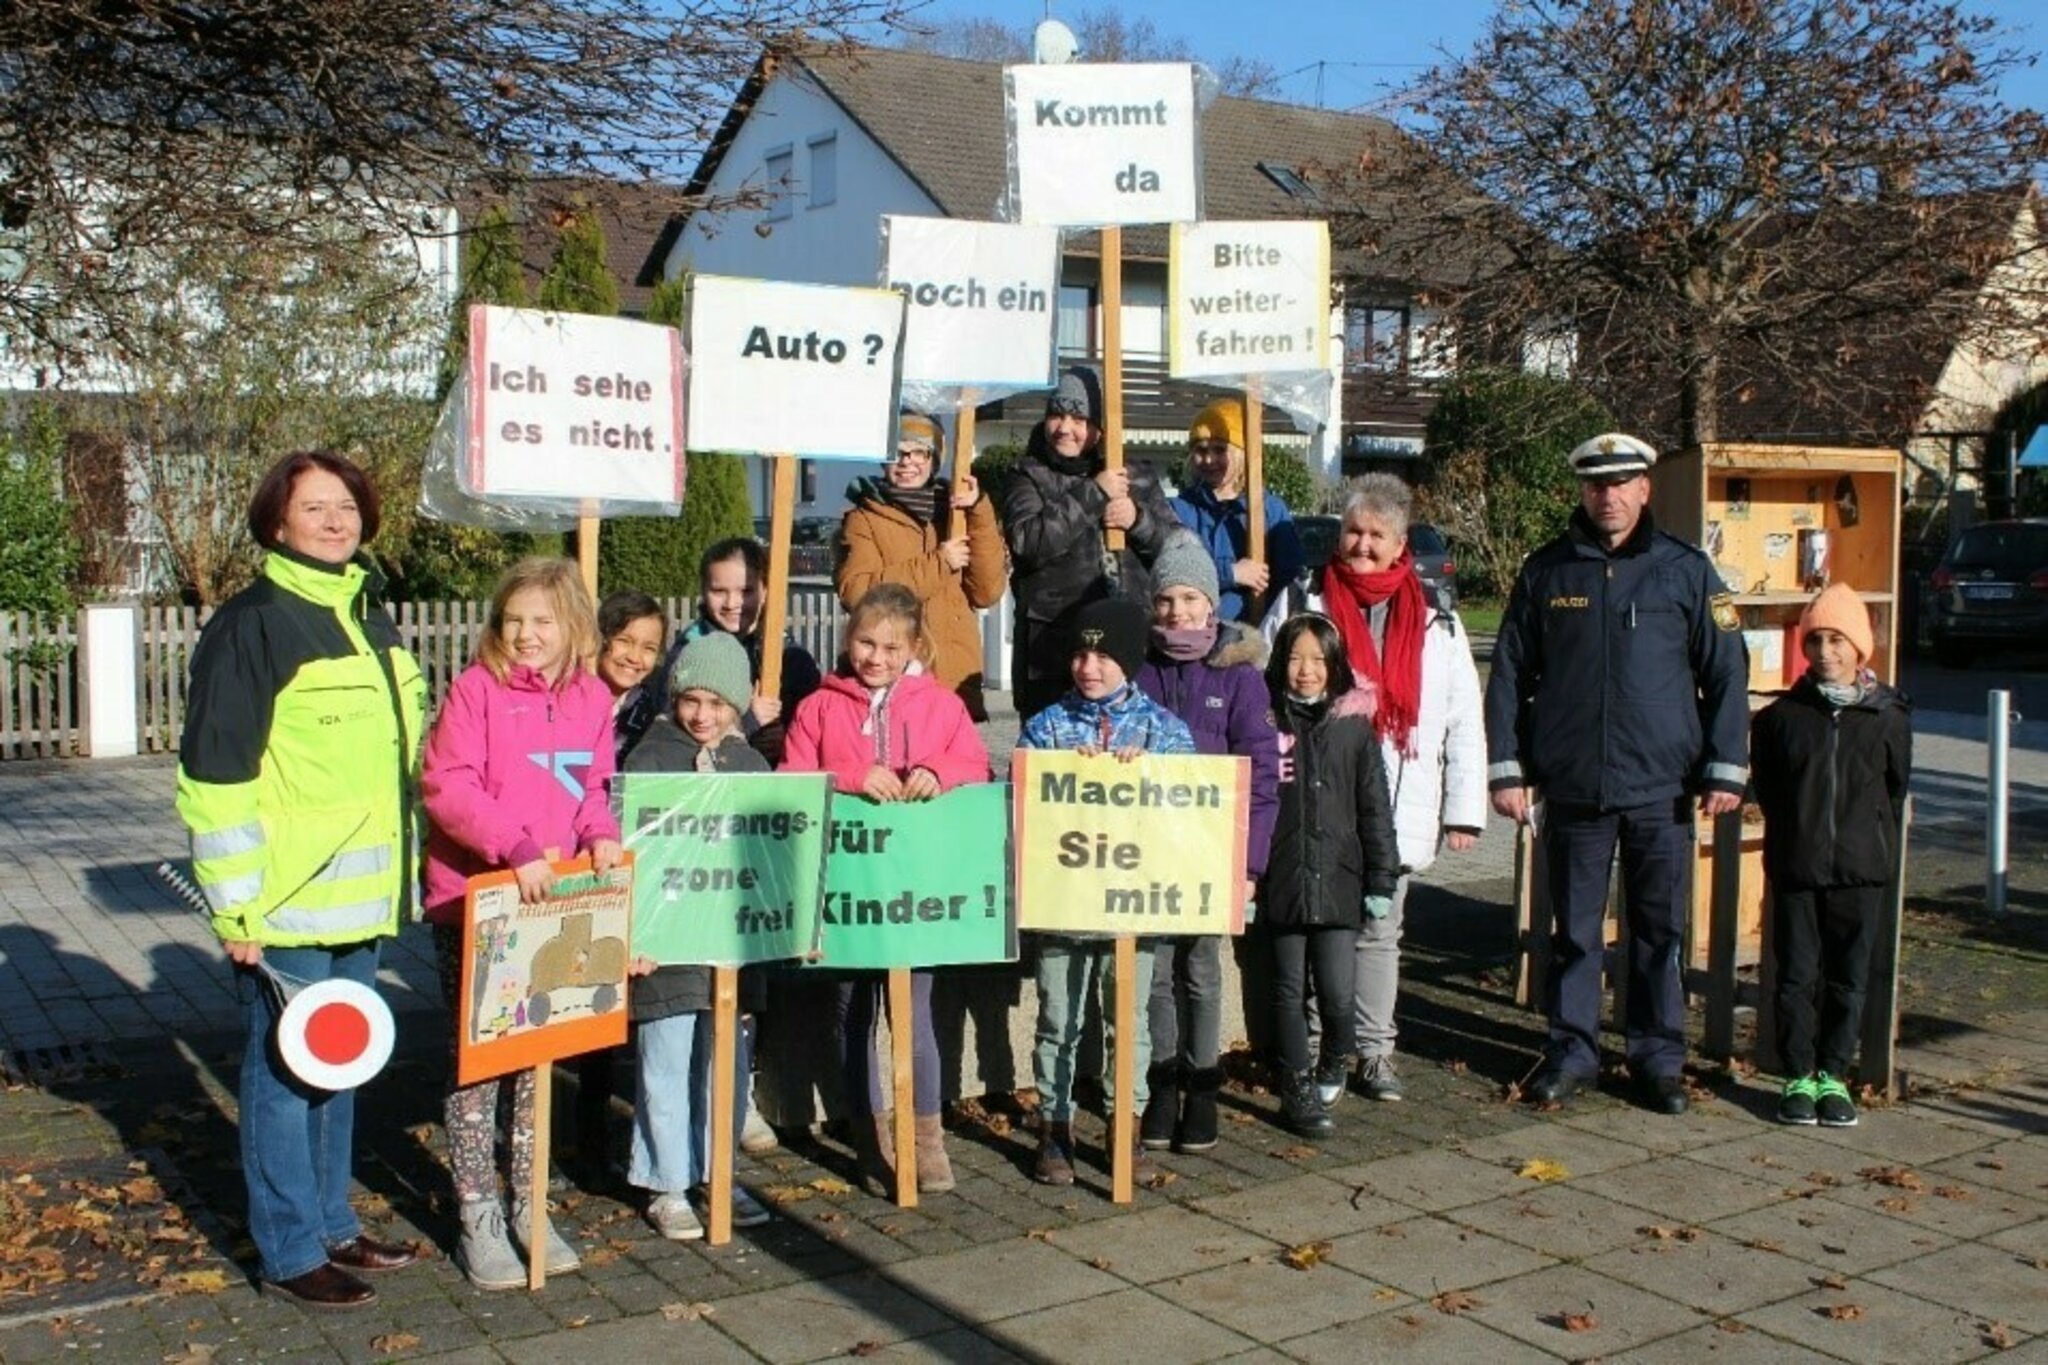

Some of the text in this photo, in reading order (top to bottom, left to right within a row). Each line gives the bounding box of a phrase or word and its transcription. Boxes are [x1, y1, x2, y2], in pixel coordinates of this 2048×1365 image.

[1034, 99, 1167, 127] Kommt
[1115, 163, 1160, 193] da
[1214, 243, 1282, 268] Bitte
[997, 281, 1047, 312] ein
[1190, 289, 1297, 315] weiter-
[741, 325, 847, 364] Auto
[1196, 329, 1293, 356] fahren
[490, 361, 652, 402] Ich sehe
[501, 420, 543, 445] es
[1040, 772, 1221, 809] Machen
[636, 807, 818, 843] Eingangs-
[829, 819, 893, 855] für
[1057, 830, 1142, 870] Sie
[661, 866, 759, 892] zone
[1104, 882, 1183, 916] mit
[735, 902, 794, 934] frei
